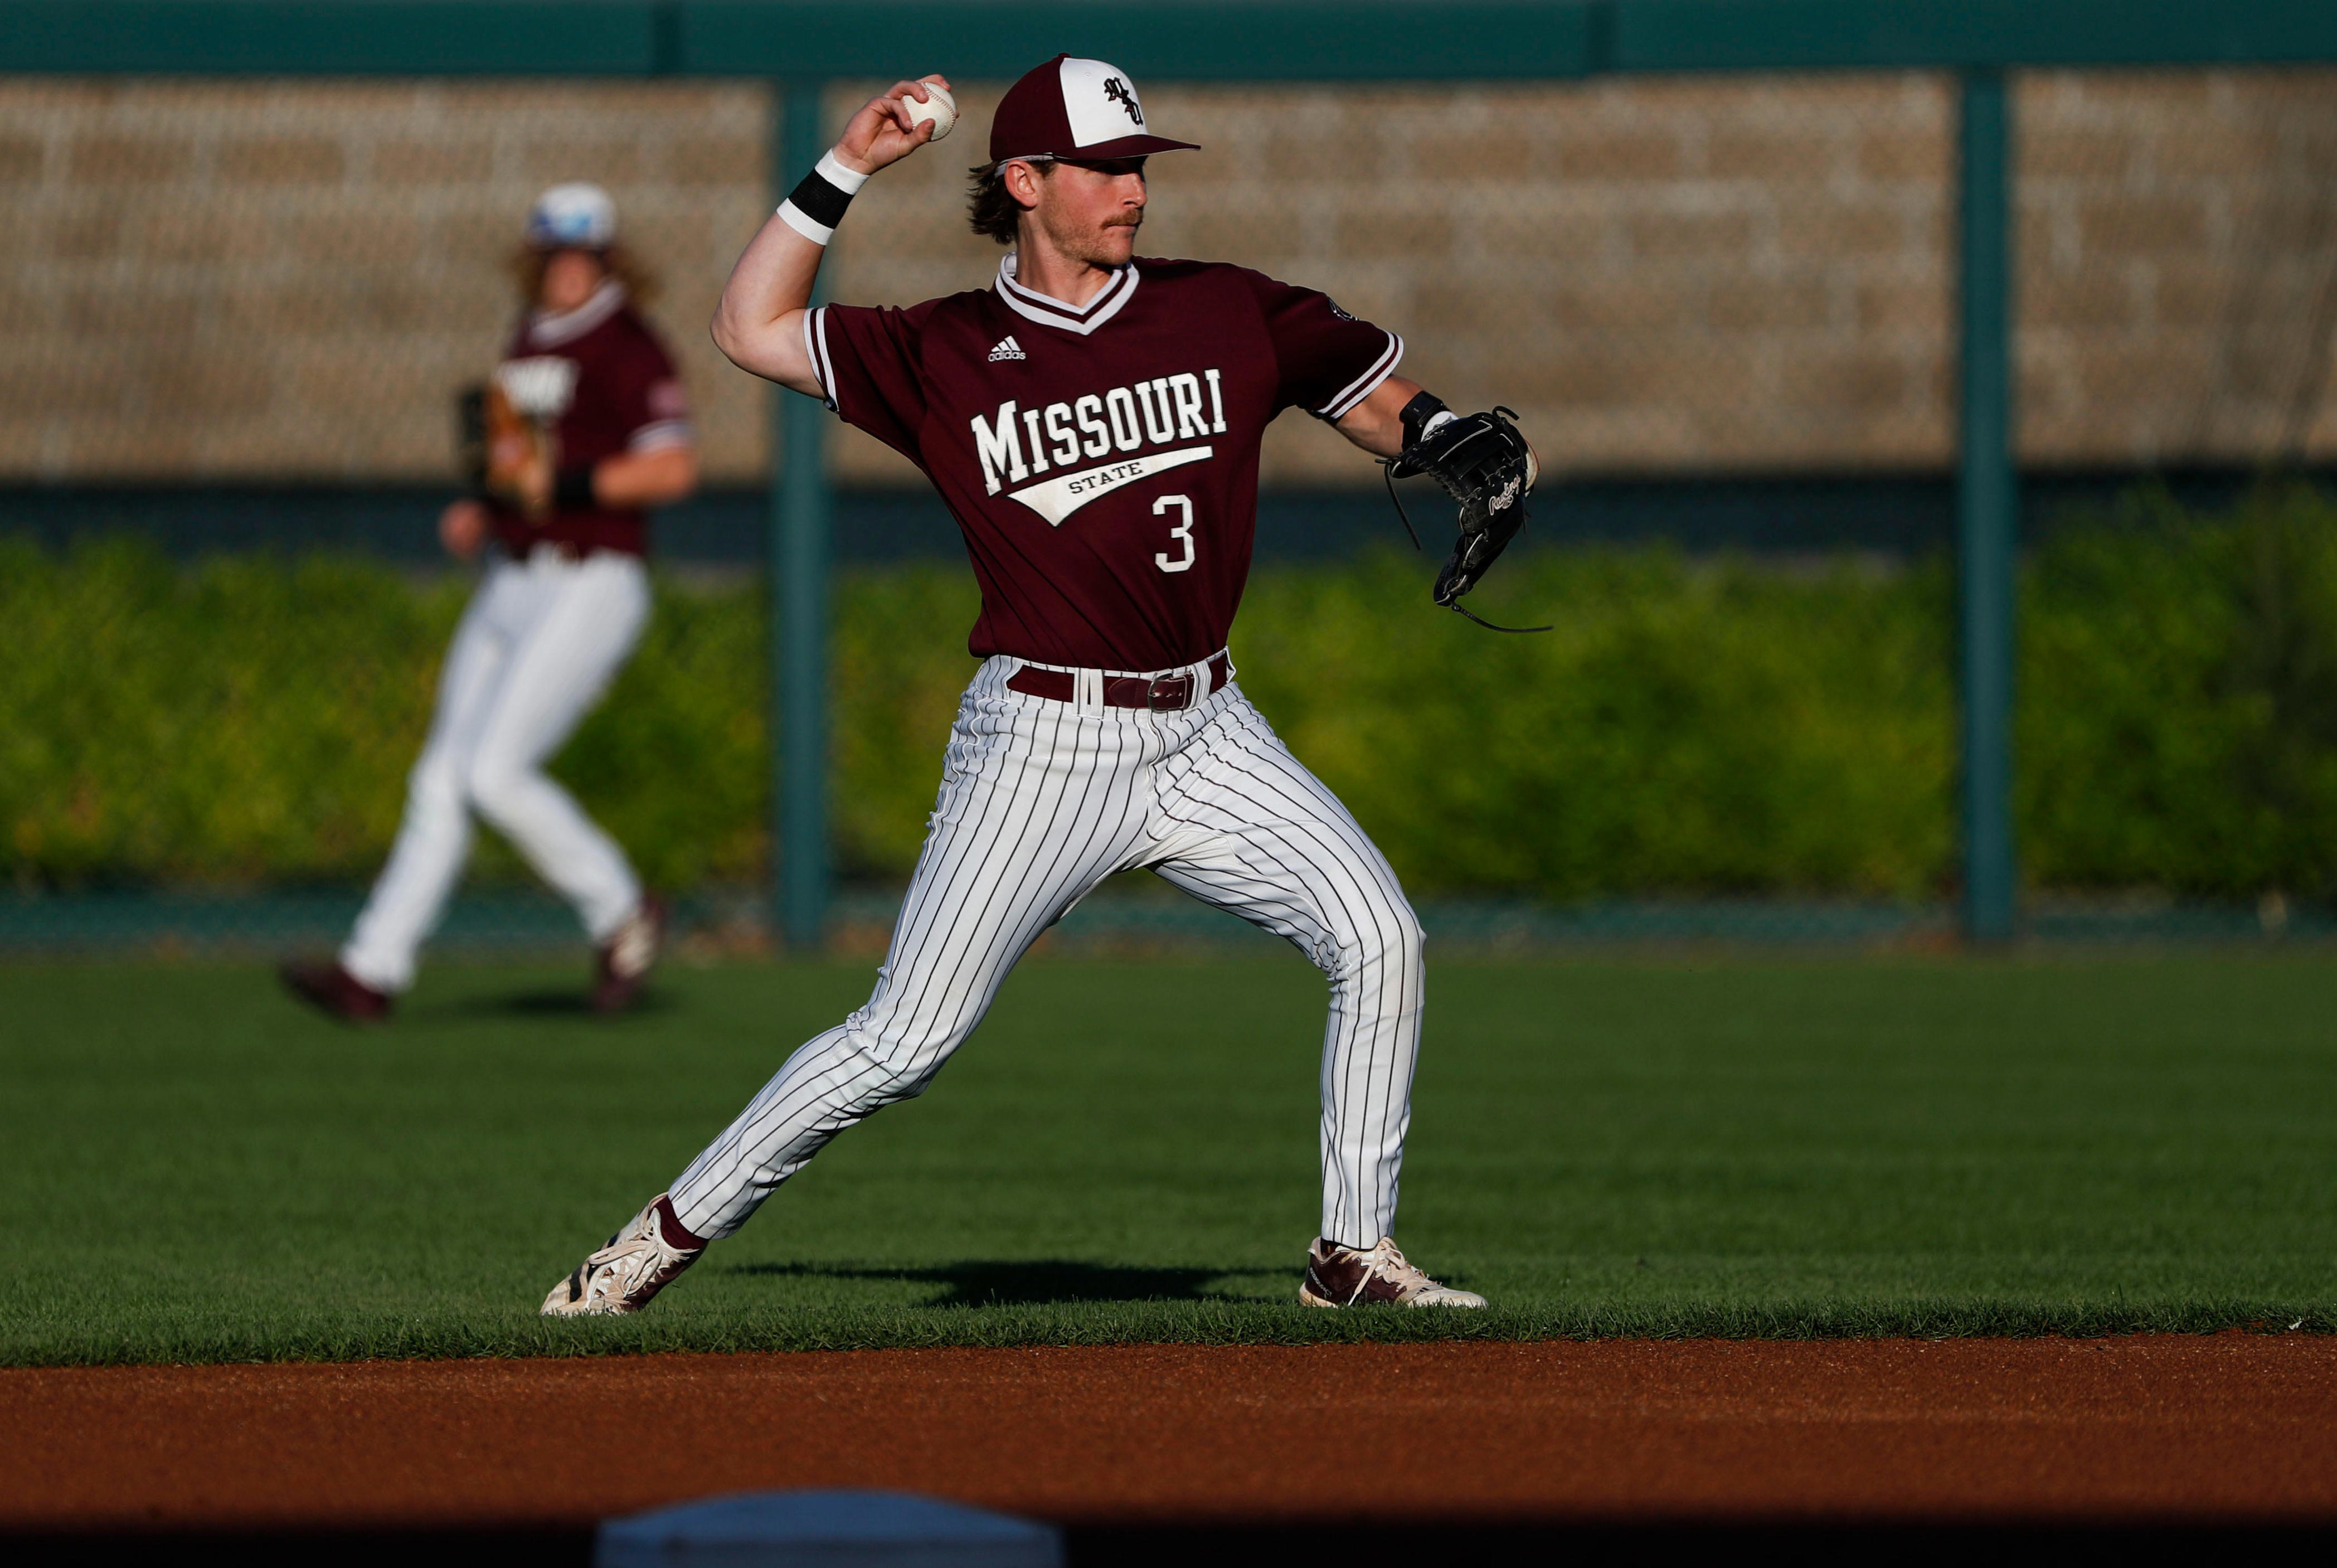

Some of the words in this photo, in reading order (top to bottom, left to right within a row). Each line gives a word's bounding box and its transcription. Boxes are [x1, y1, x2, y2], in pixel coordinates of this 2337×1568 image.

[988, 351, 1026, 362] adidas
[970, 368, 1226, 497] MISSOURI
[1068, 462, 1144, 494] STATE
[1152, 494, 1195, 573] 3
